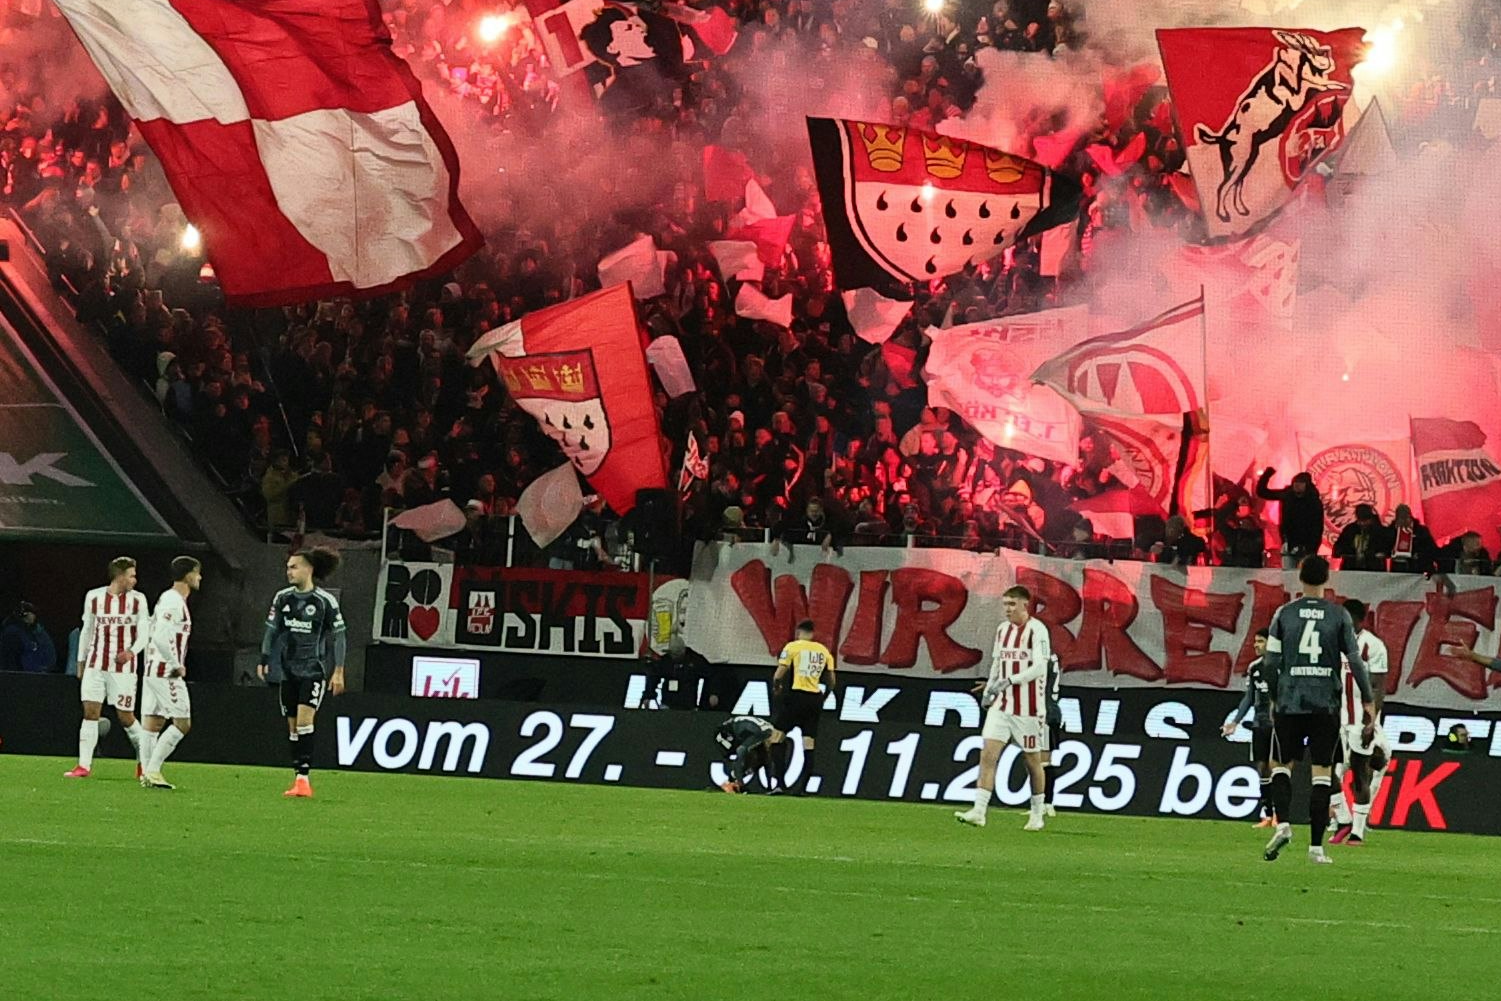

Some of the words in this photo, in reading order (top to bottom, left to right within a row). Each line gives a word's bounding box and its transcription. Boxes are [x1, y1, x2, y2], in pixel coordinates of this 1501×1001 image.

[731, 559, 984, 673] WIR
[1299, 608, 1325, 620] KOCH
[1298, 619, 1323, 665] 4
[117, 694, 132, 709] 28
[336, 716, 490, 774] vom
[510, 711, 623, 781] 27.
[1022, 734, 1037, 749] 10
